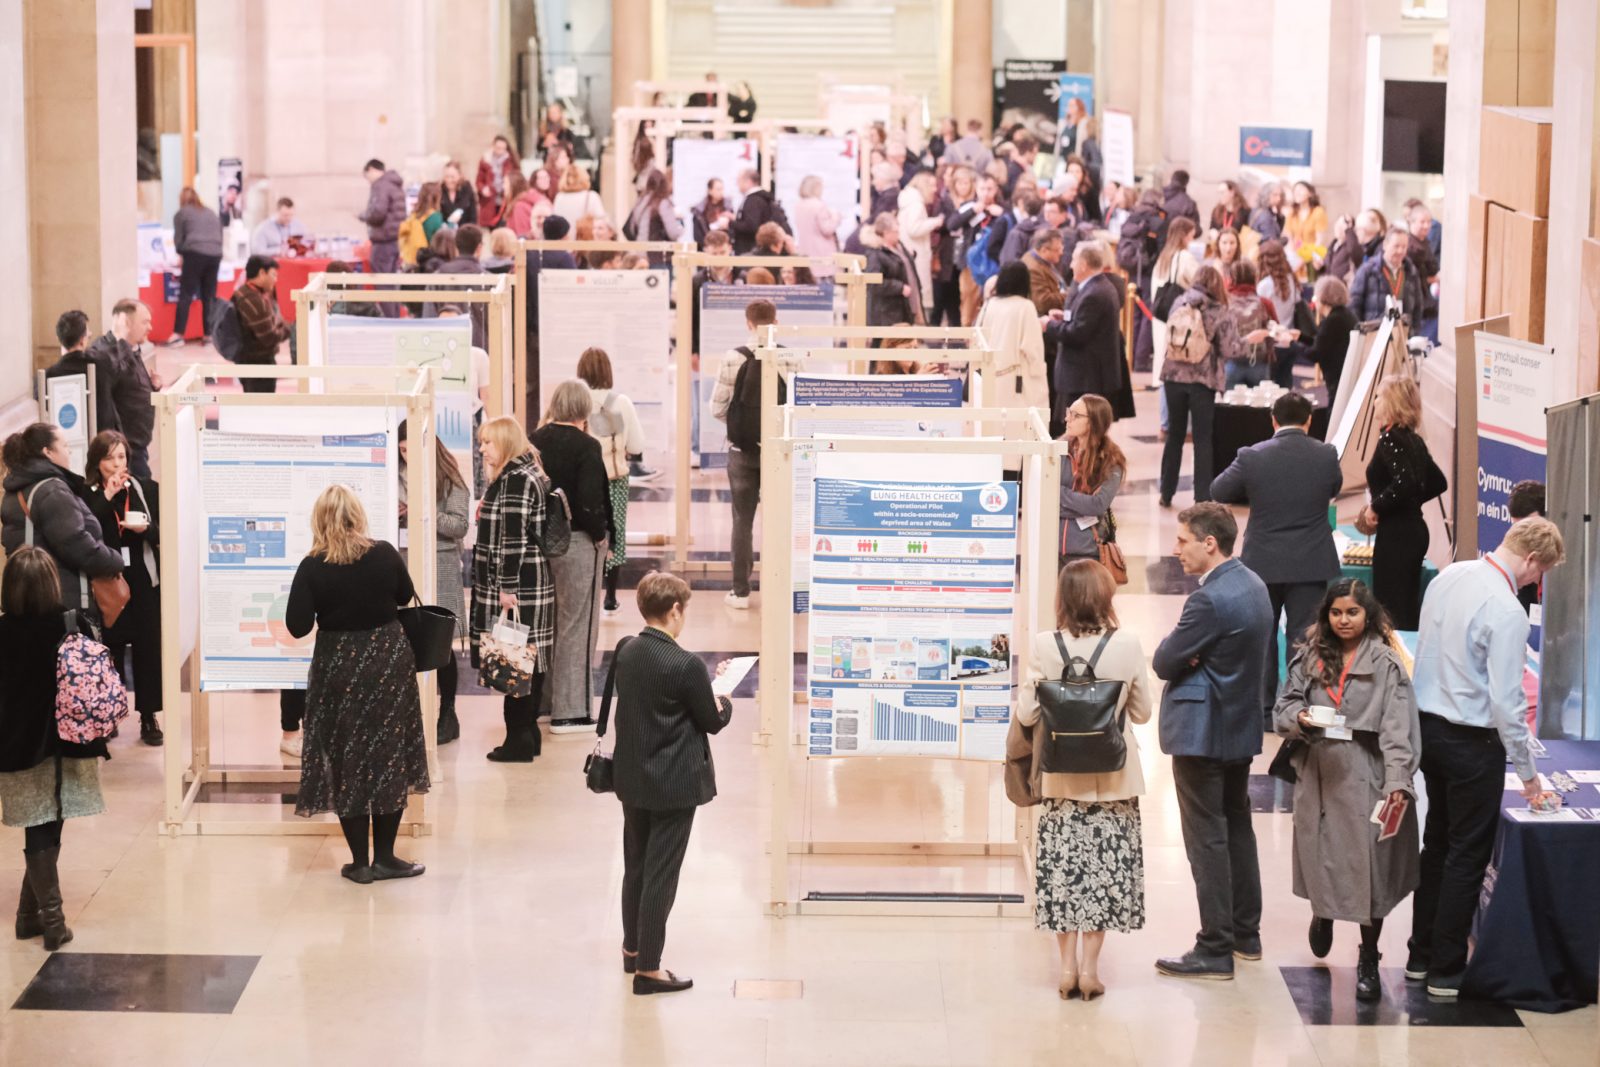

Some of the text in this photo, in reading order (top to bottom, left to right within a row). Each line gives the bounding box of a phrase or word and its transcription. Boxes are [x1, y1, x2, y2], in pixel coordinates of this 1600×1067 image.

[1493, 365, 1513, 377] cymru
[874, 491, 961, 501] LUNG HEALTH CHECK
[890, 502, 927, 510] Operational
[900, 511, 959, 520] socio-economically
[1486, 502, 1500, 520] ein
[880, 520, 909, 528] deprived
